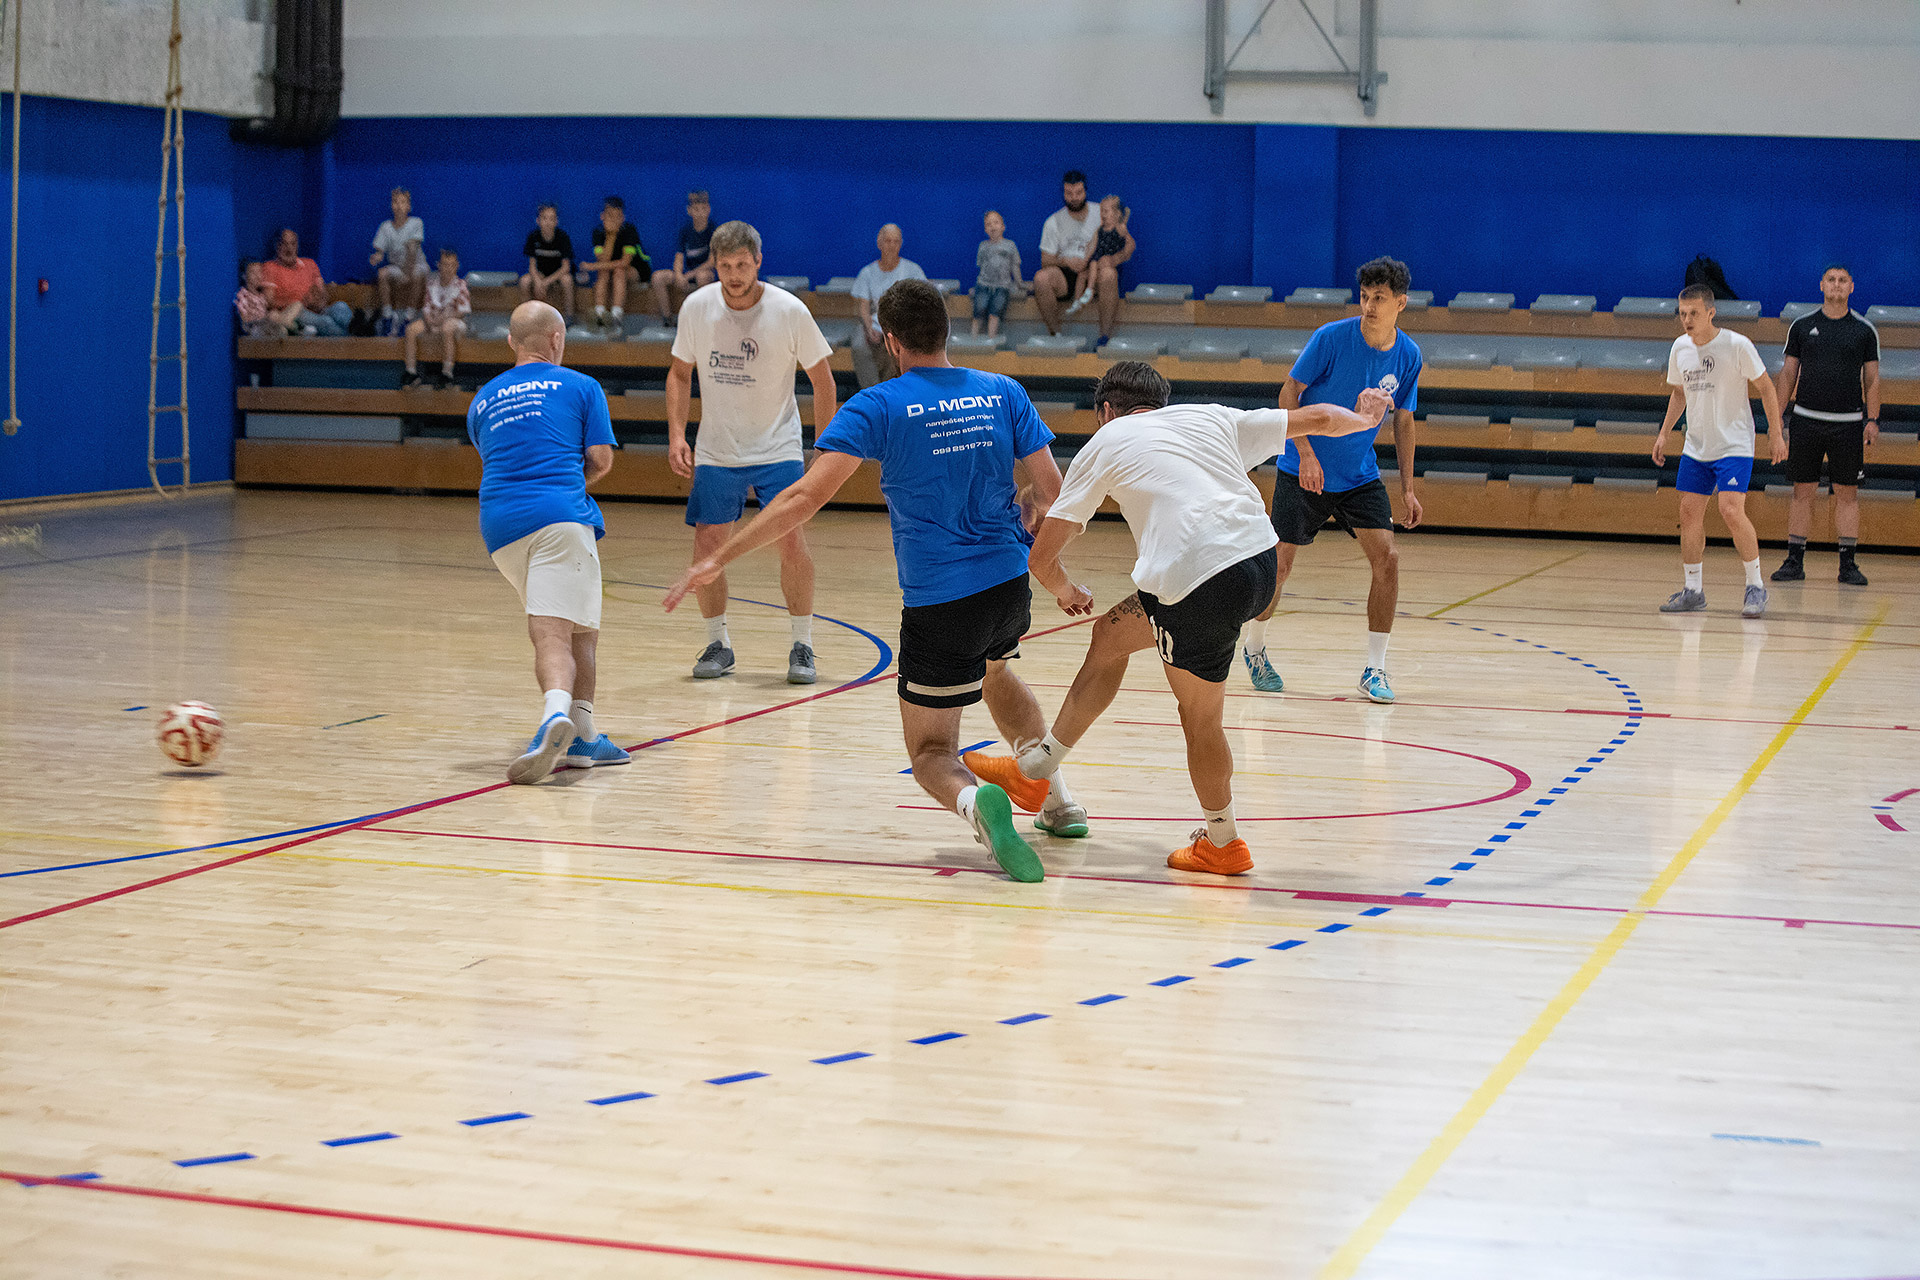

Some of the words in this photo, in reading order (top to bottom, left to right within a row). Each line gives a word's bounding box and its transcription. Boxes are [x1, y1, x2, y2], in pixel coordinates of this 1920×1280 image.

[709, 350, 720, 368] 5
[476, 399, 487, 415] D
[498, 380, 562, 398] MONT
[906, 404, 924, 418] D
[938, 394, 1002, 412] MONT
